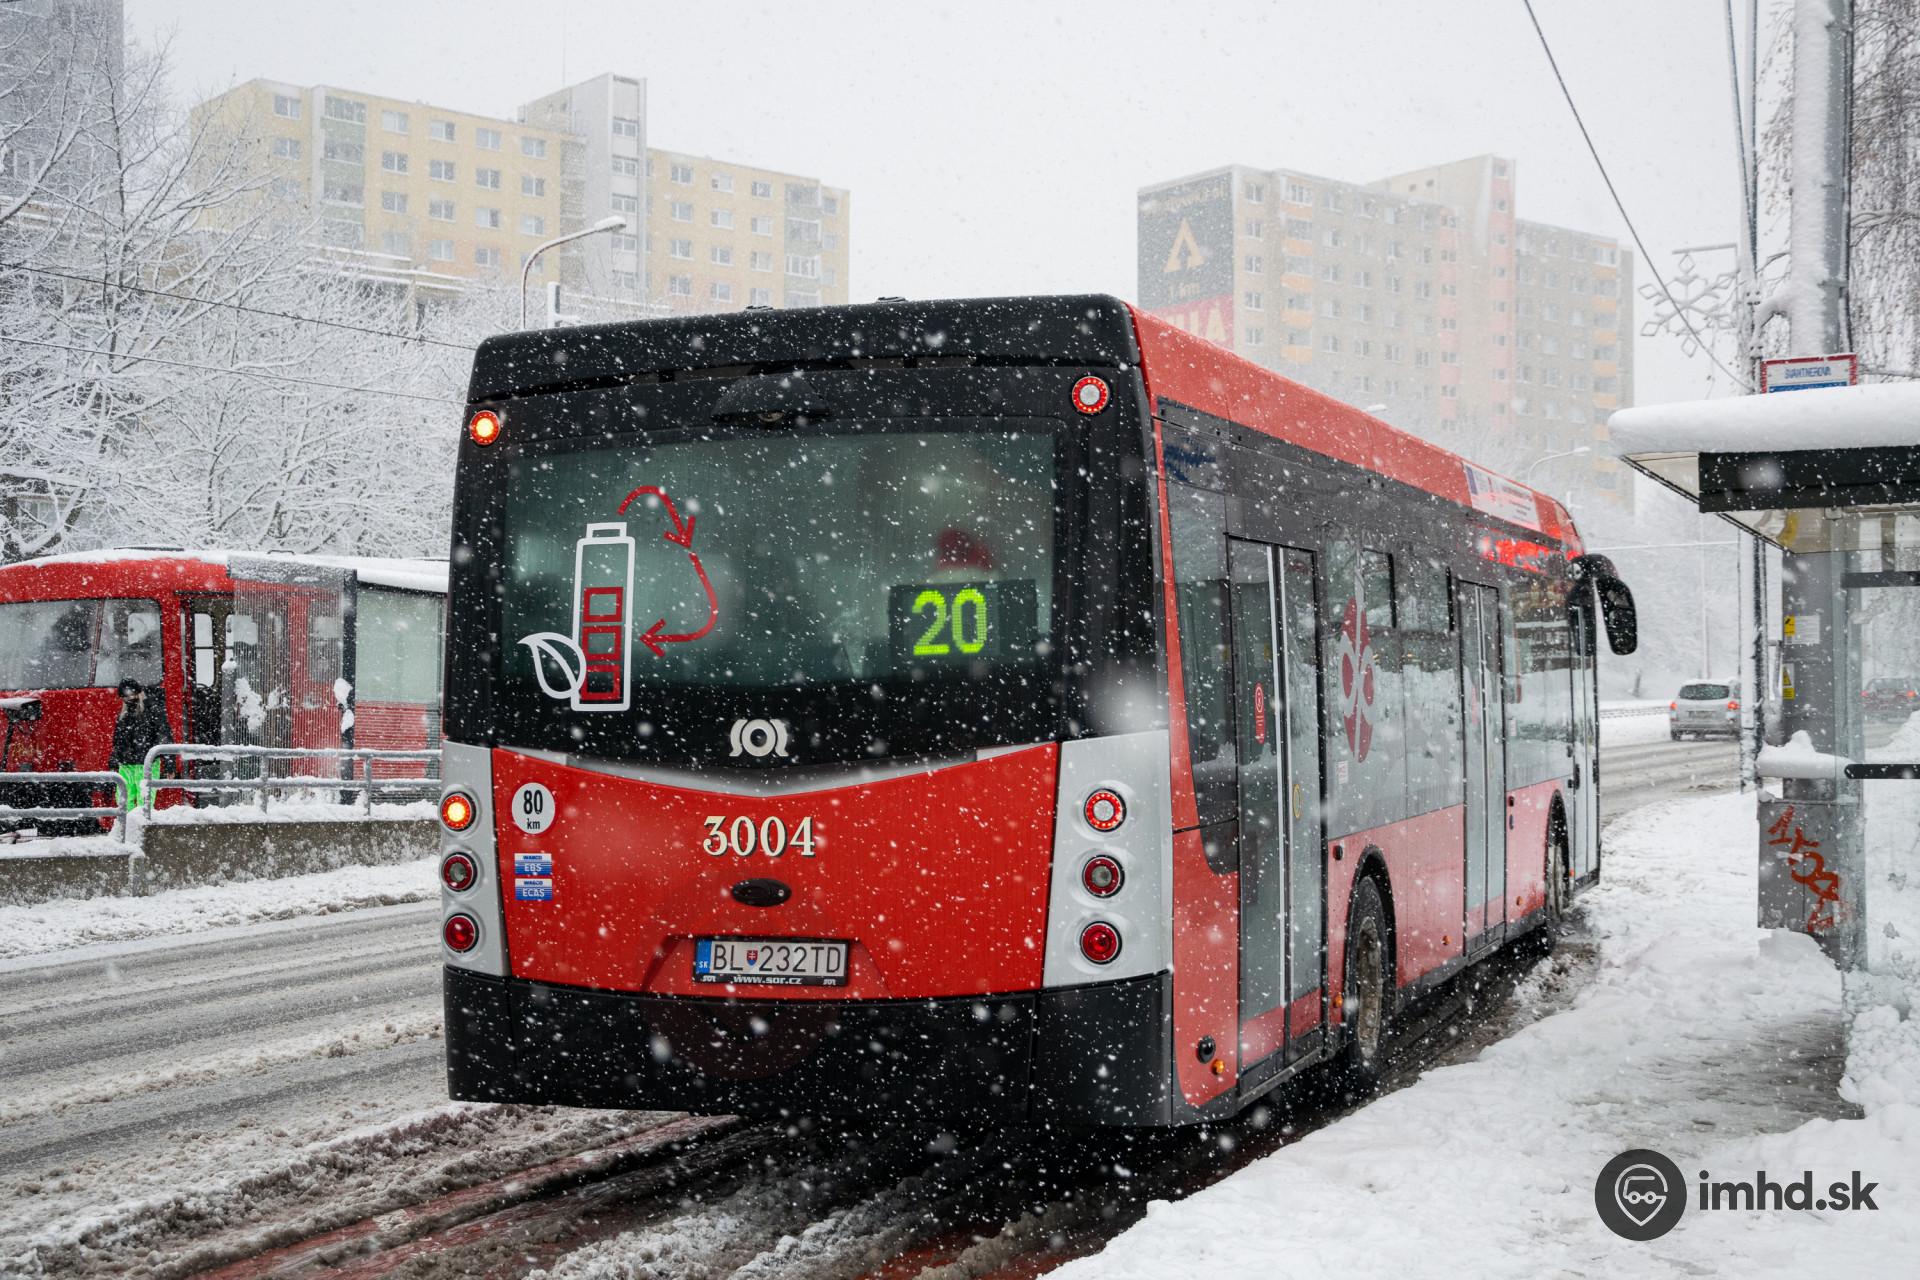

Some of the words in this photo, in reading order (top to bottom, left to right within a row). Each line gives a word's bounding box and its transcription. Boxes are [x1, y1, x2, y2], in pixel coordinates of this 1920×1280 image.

[911, 588, 987, 656] 20
[523, 789, 543, 815] 80
[526, 818, 541, 830] km
[702, 815, 816, 857] 3004
[524, 863, 542, 872] EBS
[522, 888, 545, 897] ECAS
[698, 961, 708, 969] SK
[733, 974, 802, 985] www.sor.cz
